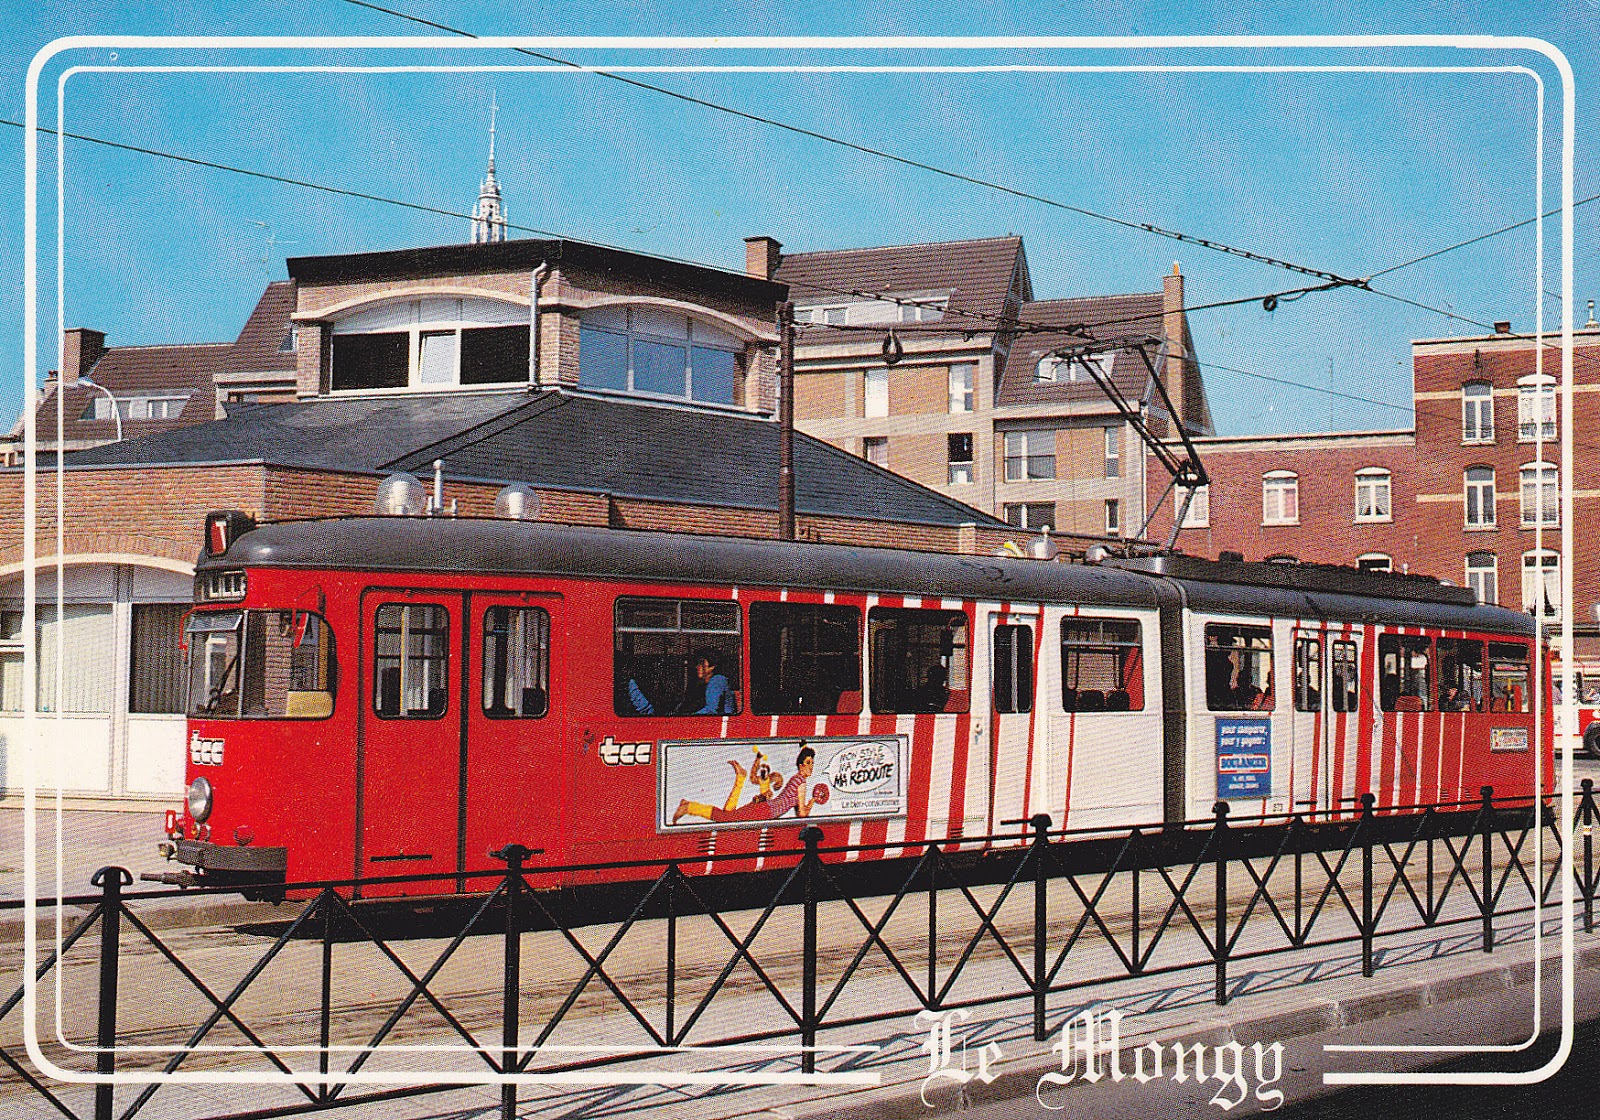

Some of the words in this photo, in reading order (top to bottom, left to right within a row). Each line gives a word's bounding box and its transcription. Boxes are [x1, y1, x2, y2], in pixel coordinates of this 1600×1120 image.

[1221, 757, 1267, 769] BOULANGER
[833, 773, 848, 788] MA
[850, 762, 894, 785] REDOUTE
